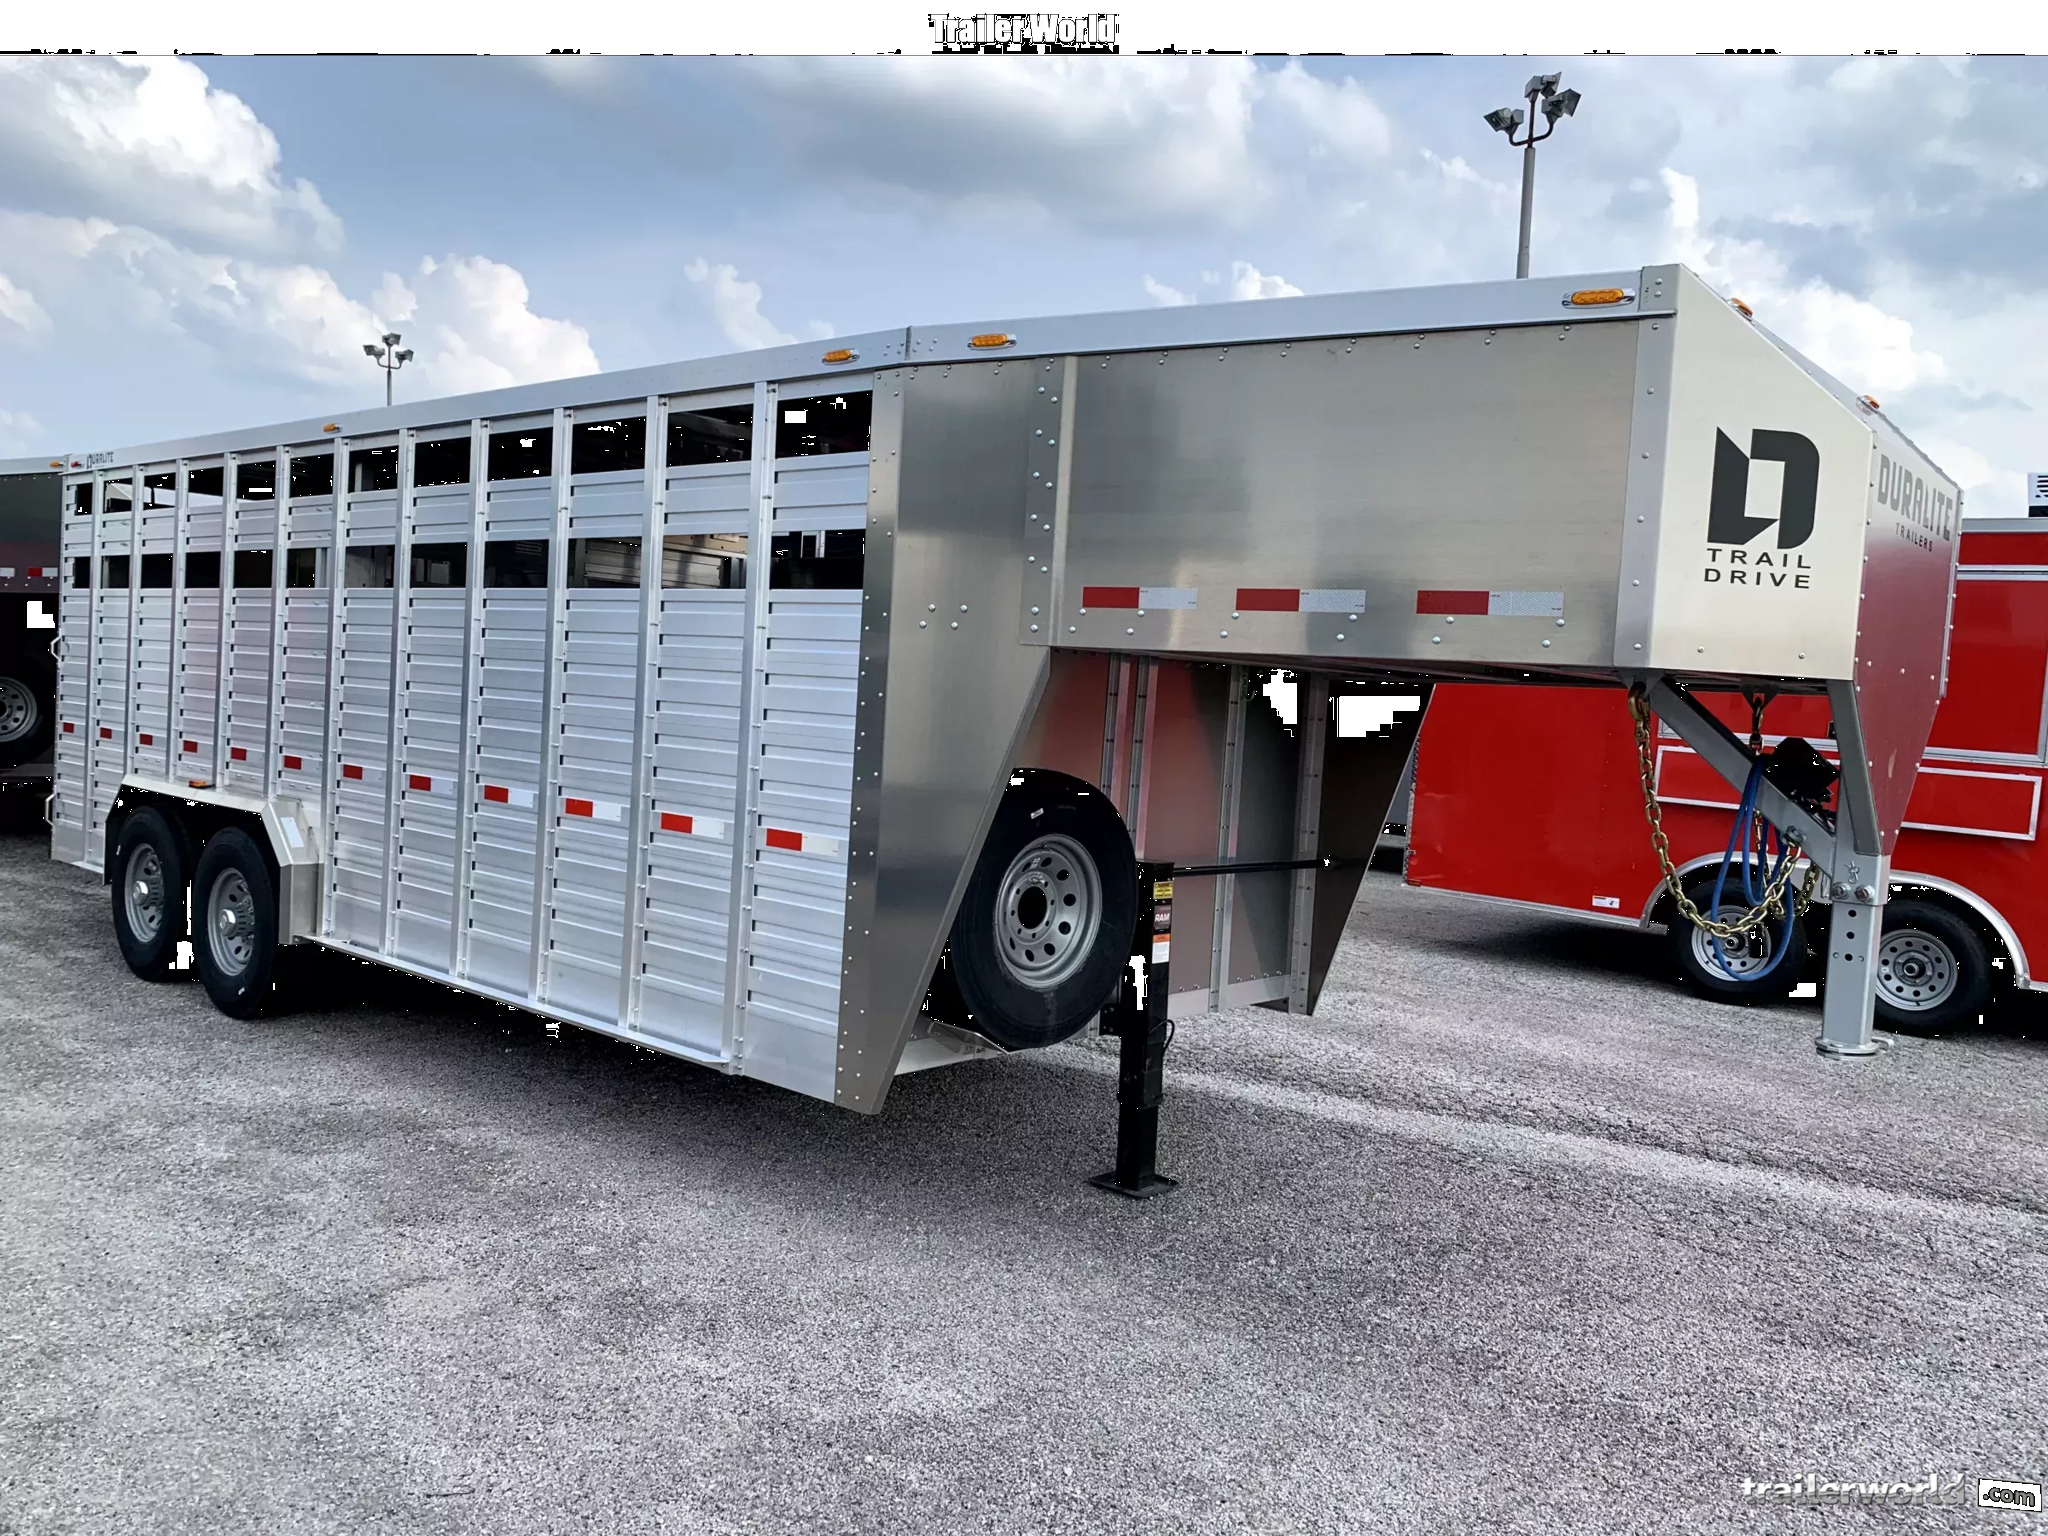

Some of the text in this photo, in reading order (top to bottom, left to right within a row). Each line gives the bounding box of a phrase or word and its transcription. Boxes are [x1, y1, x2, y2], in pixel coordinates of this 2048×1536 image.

[1877, 453, 1954, 542] DURALITE
[1895, 522, 1933, 552] TRAILERS
[1706, 548, 1812, 570] TRAIL
[1703, 567, 1811, 590] DRIVE
[1154, 913, 1171, 923] RAM
